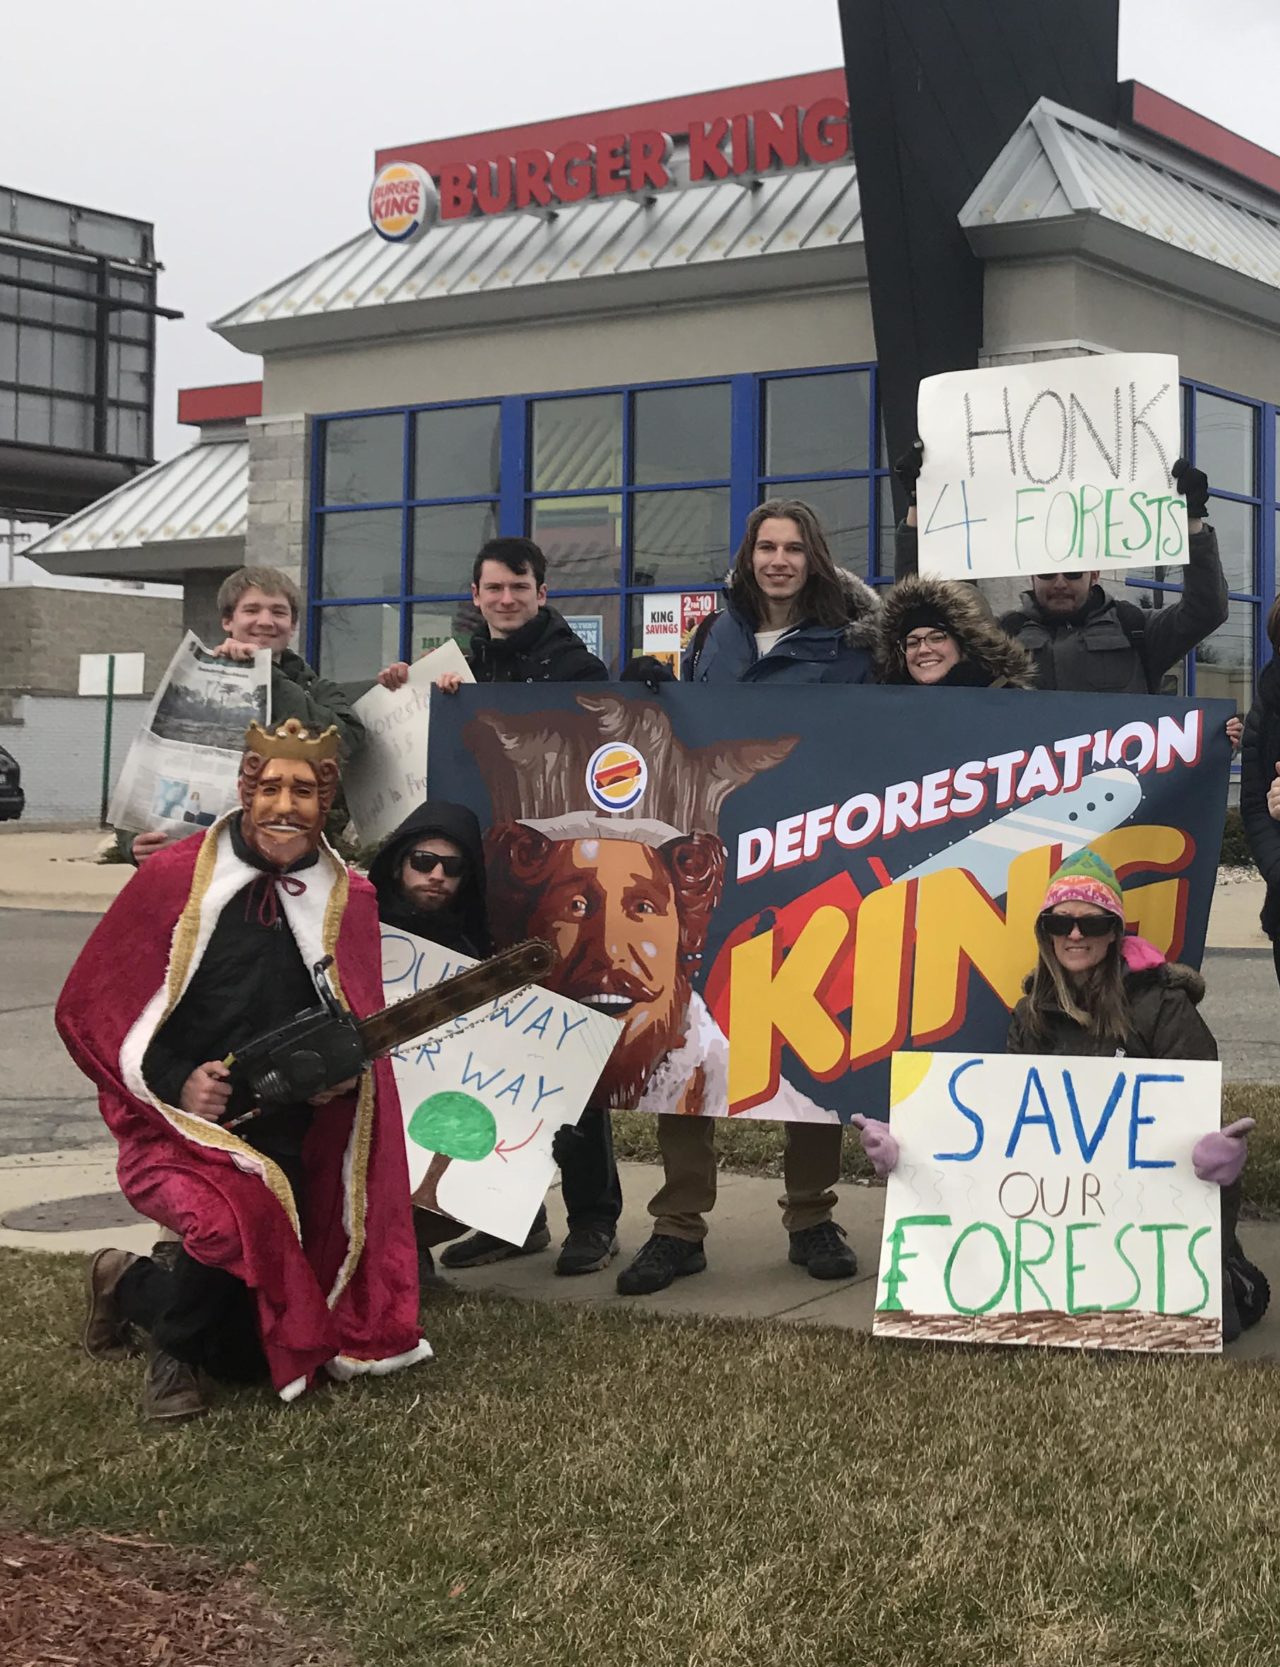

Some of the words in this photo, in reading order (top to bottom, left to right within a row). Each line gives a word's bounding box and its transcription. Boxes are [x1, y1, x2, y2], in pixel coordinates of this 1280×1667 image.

[440, 130, 669, 219] BURGER
[688, 98, 850, 182] KING
[374, 180, 420, 199] BURGER
[374, 195, 420, 219] KING
[963, 381, 1172, 488] HONK
[924, 480, 987, 570] 4
[1014, 484, 1186, 570] FORESTS
[646, 624, 678, 634] SAVINGS
[651, 611, 674, 623] KING
[684, 596, 692, 611] 2
[736, 709, 1203, 884] DEFORESTATION
[728, 824, 1196, 1114] KING
[490, 996, 588, 1050] WAY
[461, 1052, 564, 1112] WAY
[933, 1059, 1185, 1169] SAVE
[999, 1171, 1106, 1218] OUR
[875, 1215, 1212, 1315] FORESTS
